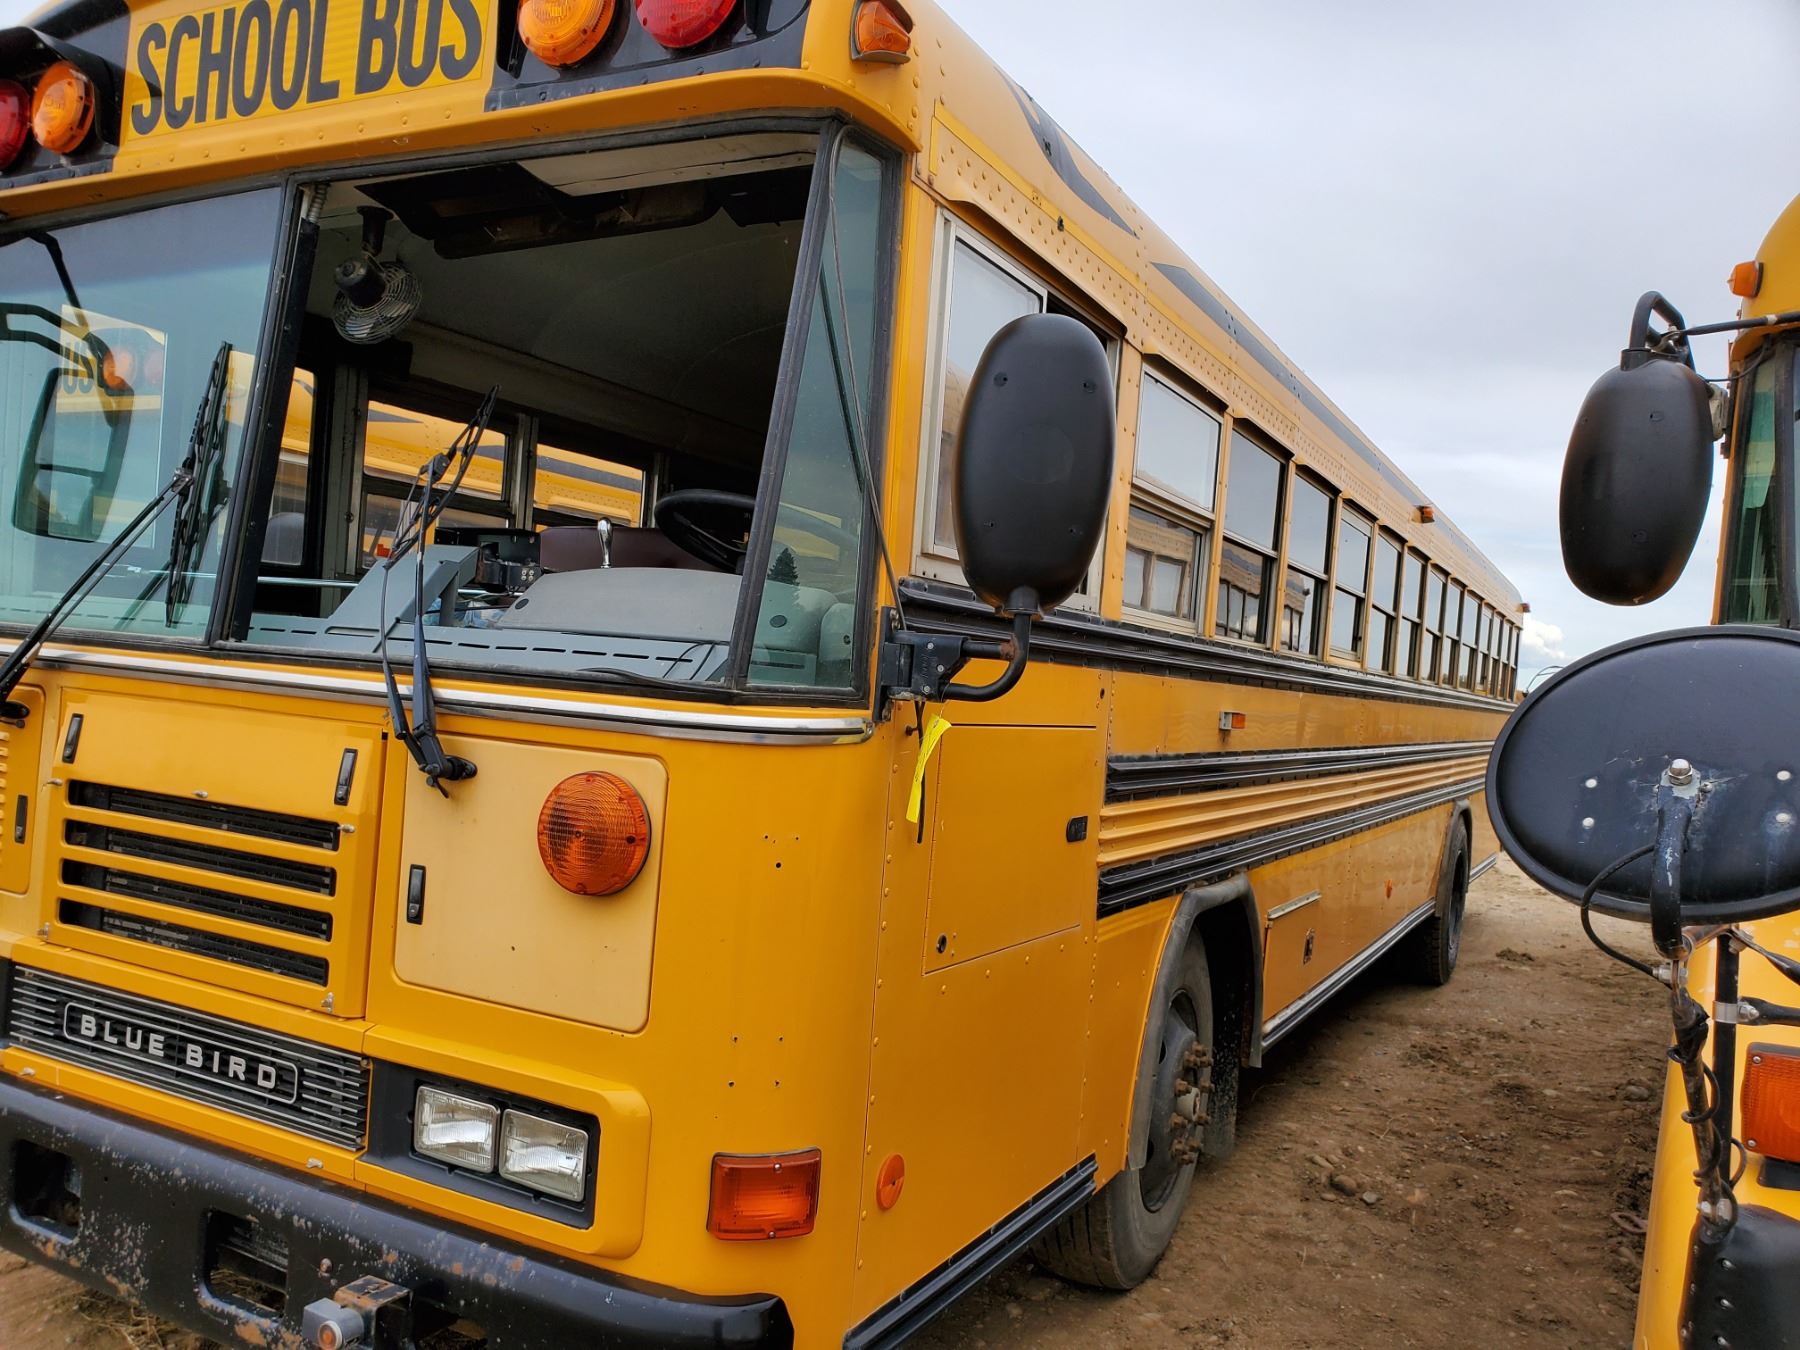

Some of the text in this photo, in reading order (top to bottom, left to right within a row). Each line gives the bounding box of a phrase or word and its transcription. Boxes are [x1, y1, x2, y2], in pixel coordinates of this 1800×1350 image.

[131, 0, 482, 135] SCHOOL BUS
[80, 1014, 277, 1090] BLUE BIRD
